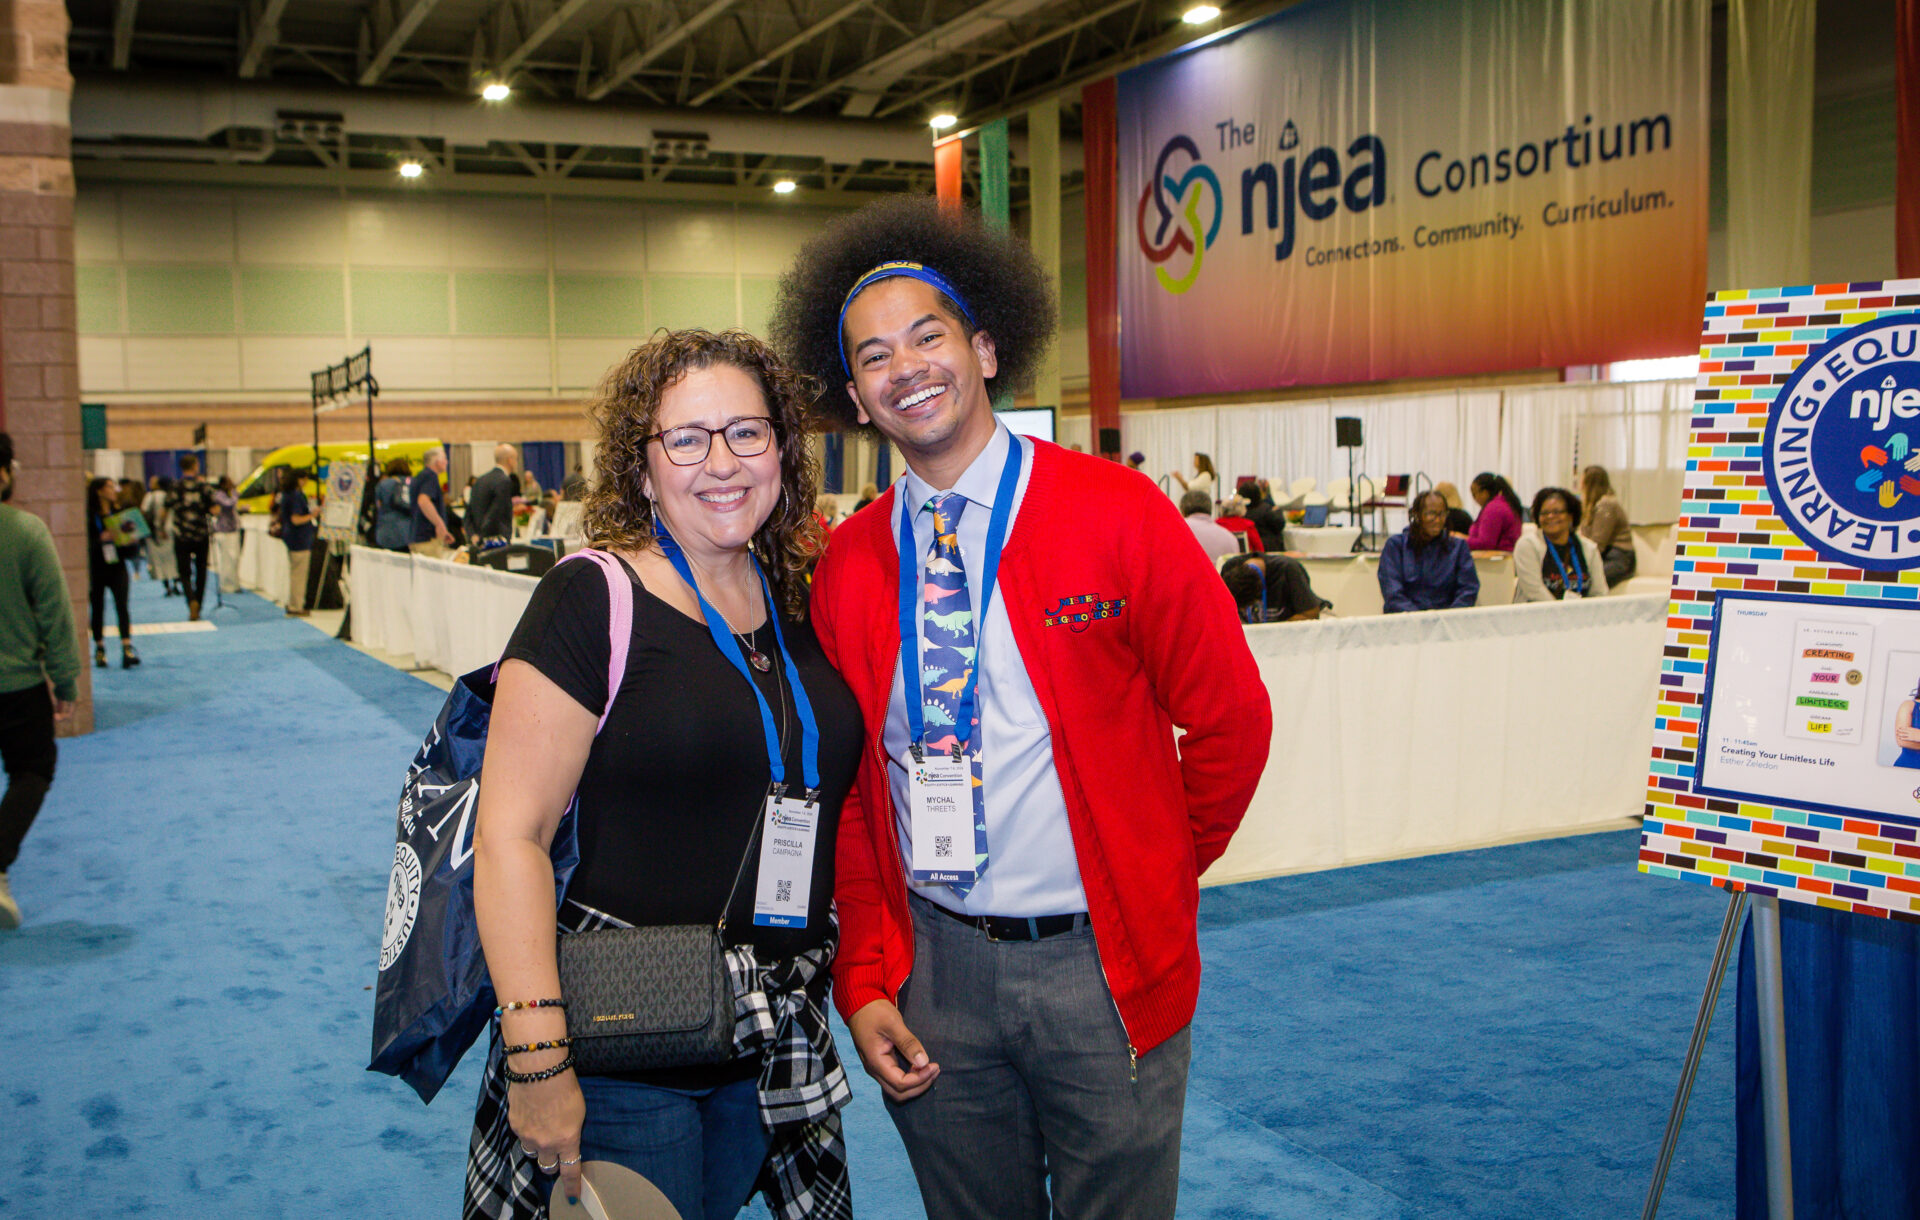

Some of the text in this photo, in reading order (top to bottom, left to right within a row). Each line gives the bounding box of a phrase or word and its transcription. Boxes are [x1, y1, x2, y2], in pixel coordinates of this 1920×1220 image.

[1216, 118, 1255, 151] The
[1241, 114, 1671, 262] njea Consortium
[1305, 188, 1675, 267] Connectons. Community. Curriculum.
[1780, 395, 1899, 553] LEARNING
[1804, 648, 1852, 660] CREATING
[1812, 673, 1838, 683] YOUR
[1799, 696, 1847, 709] LIMITLESS
[1810, 722, 1830, 733] LIFE
[1719, 755, 1744, 765] Esther
[1721, 745, 1836, 767] Creating Your Limitless Life
[926, 796, 955, 805] MYCHAL
[926, 805, 957, 813] THREETS
[773, 838, 803, 849] PRISCILLA
[772, 847, 803, 857] CAMPAGNA
[930, 873, 959, 881] All Access
[769, 916, 791, 926] Member
